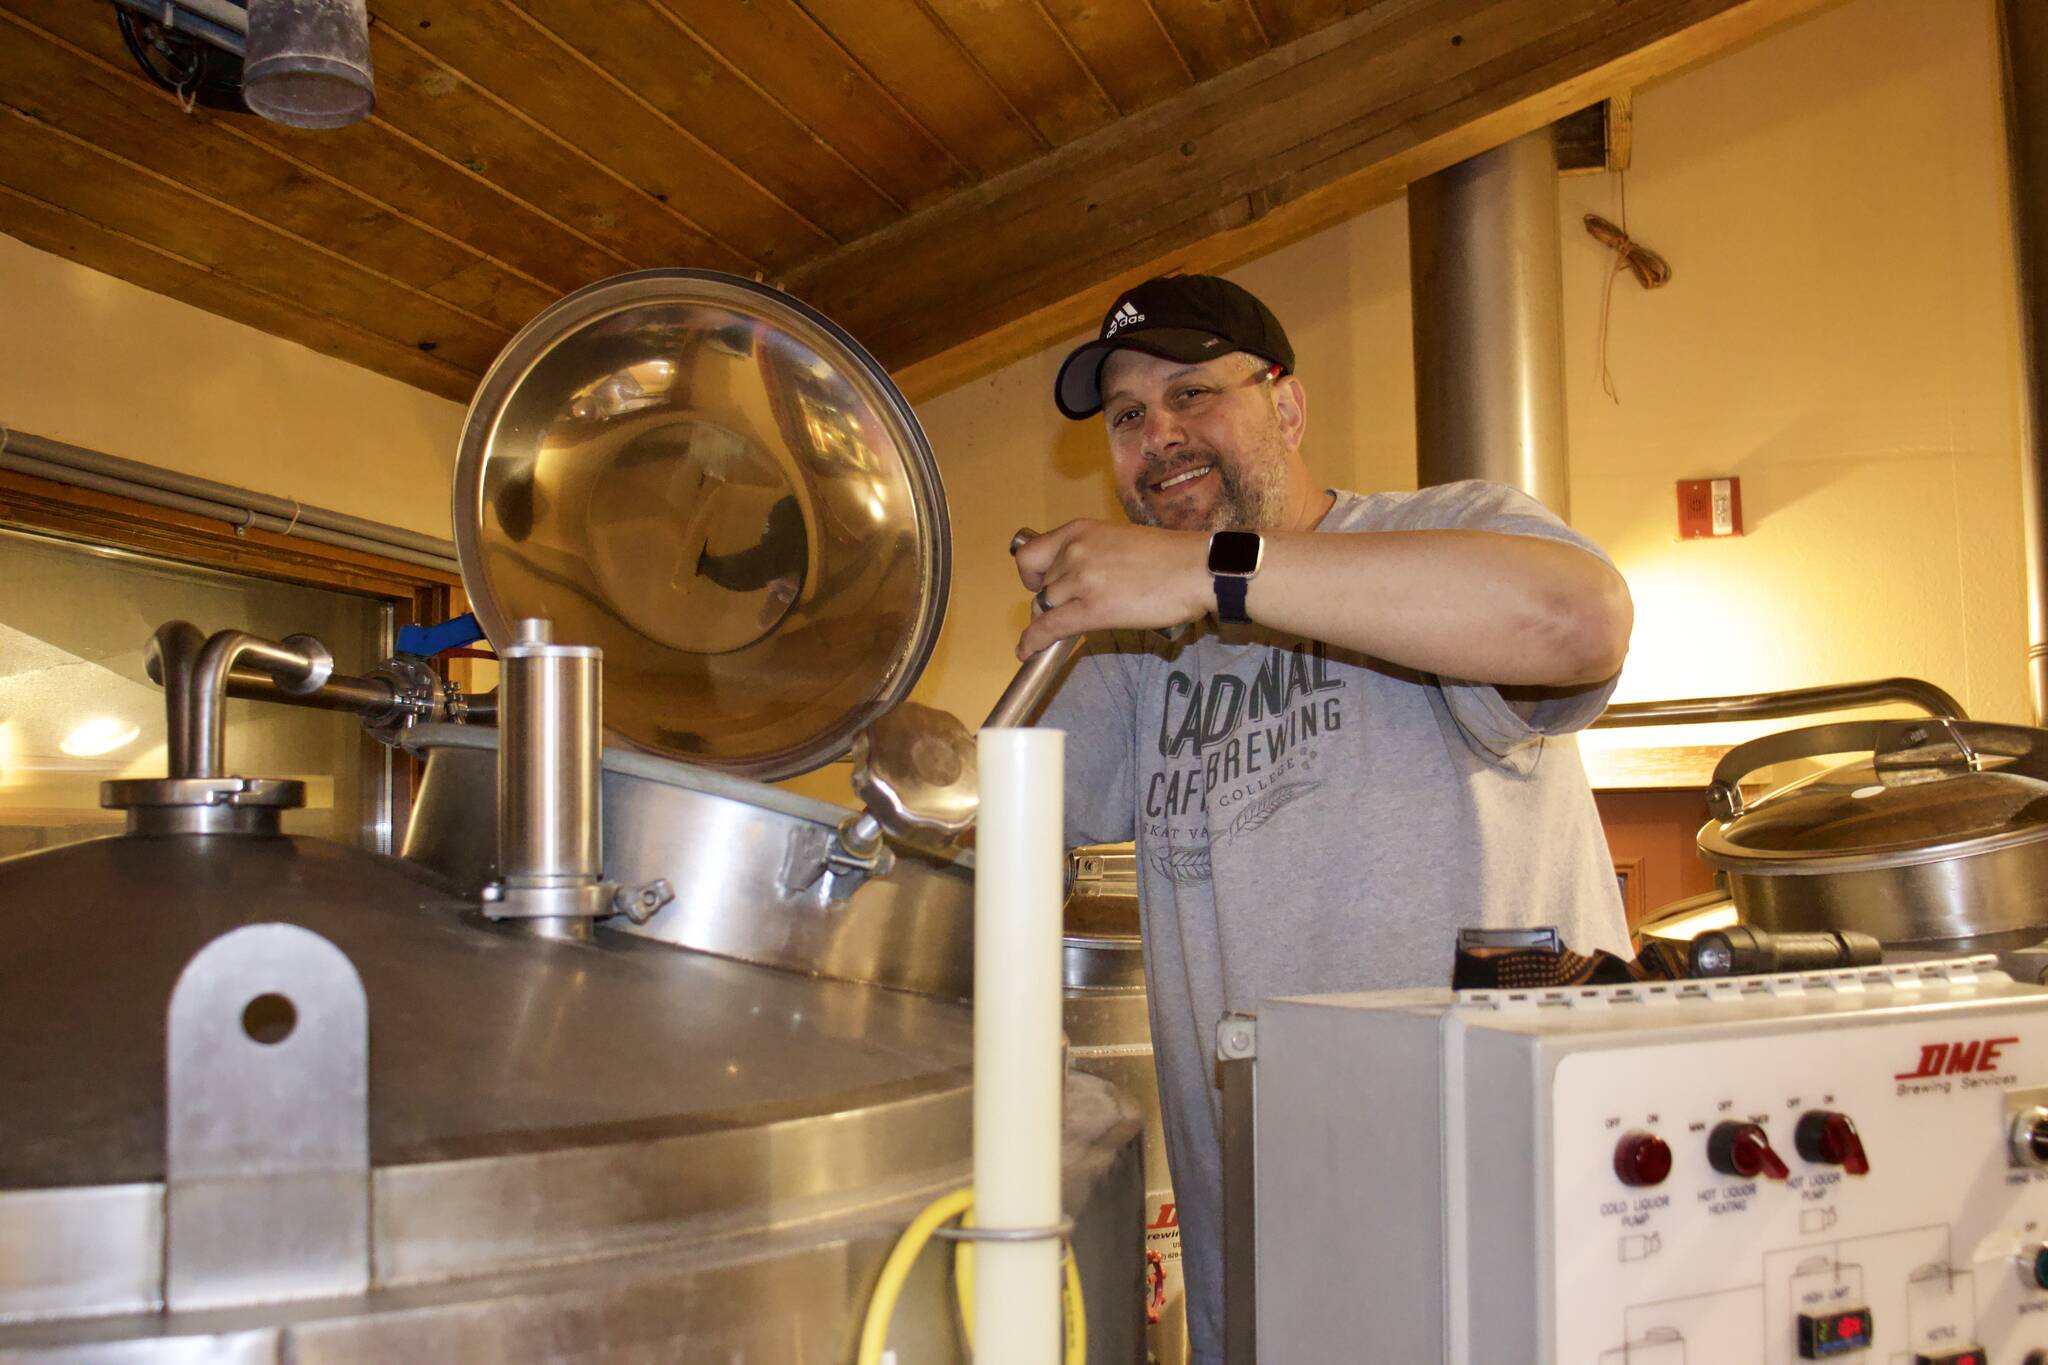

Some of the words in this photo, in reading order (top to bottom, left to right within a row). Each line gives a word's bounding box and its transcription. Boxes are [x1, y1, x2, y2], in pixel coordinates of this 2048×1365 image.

[1106, 313, 1145, 339] addas
[1206, 697, 1341, 795] BREWING
[1219, 758, 1296, 808] COLLEGE
[1894, 1036, 2020, 1081] DME
[1896, 1081, 1952, 1097] Brewing
[1960, 1074, 2018, 1090] Services
[1646, 1113, 1659, 1124] ON
[1697, 1188, 1717, 1202] HOT
[1722, 1183, 1757, 1199] LIQUOR
[1600, 1202, 1627, 1216] COLD
[1633, 1195, 1671, 1211] LIQUOR
[1621, 1213, 1650, 1227] PUMP
